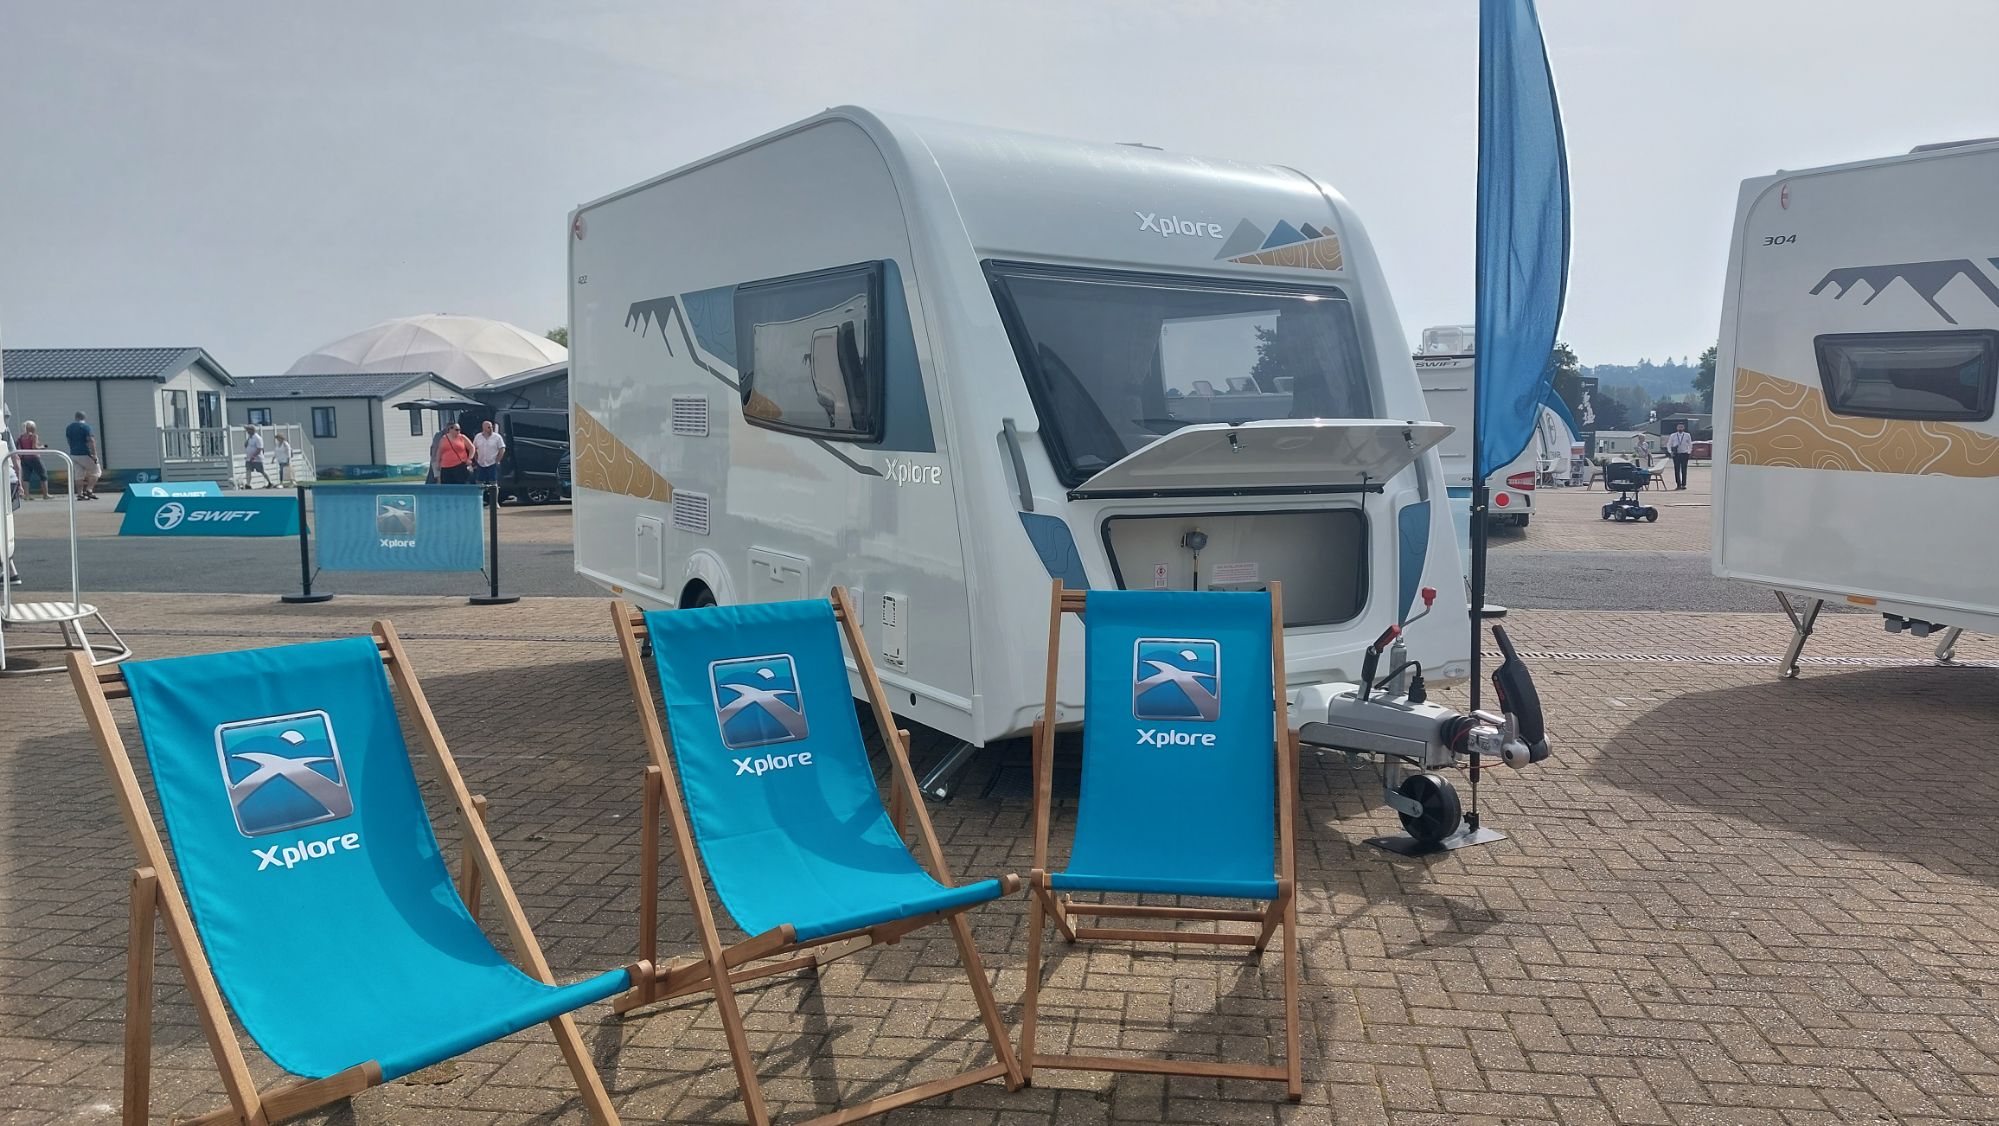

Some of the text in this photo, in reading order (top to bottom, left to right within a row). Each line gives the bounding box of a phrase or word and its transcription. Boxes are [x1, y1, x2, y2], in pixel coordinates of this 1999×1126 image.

[1135, 211, 1224, 239] Xplore
[1762, 234, 1797, 247] 304
[1415, 360, 1461, 368] SWIFT
[884, 457, 942, 487] Xplore
[187, 510, 261, 522] SWIFT
[380, 538, 416, 549] Xplore
[1136, 728, 1217, 748] Xplore
[731, 751, 813, 777] Xplore
[251, 832, 361, 871] Xplore
